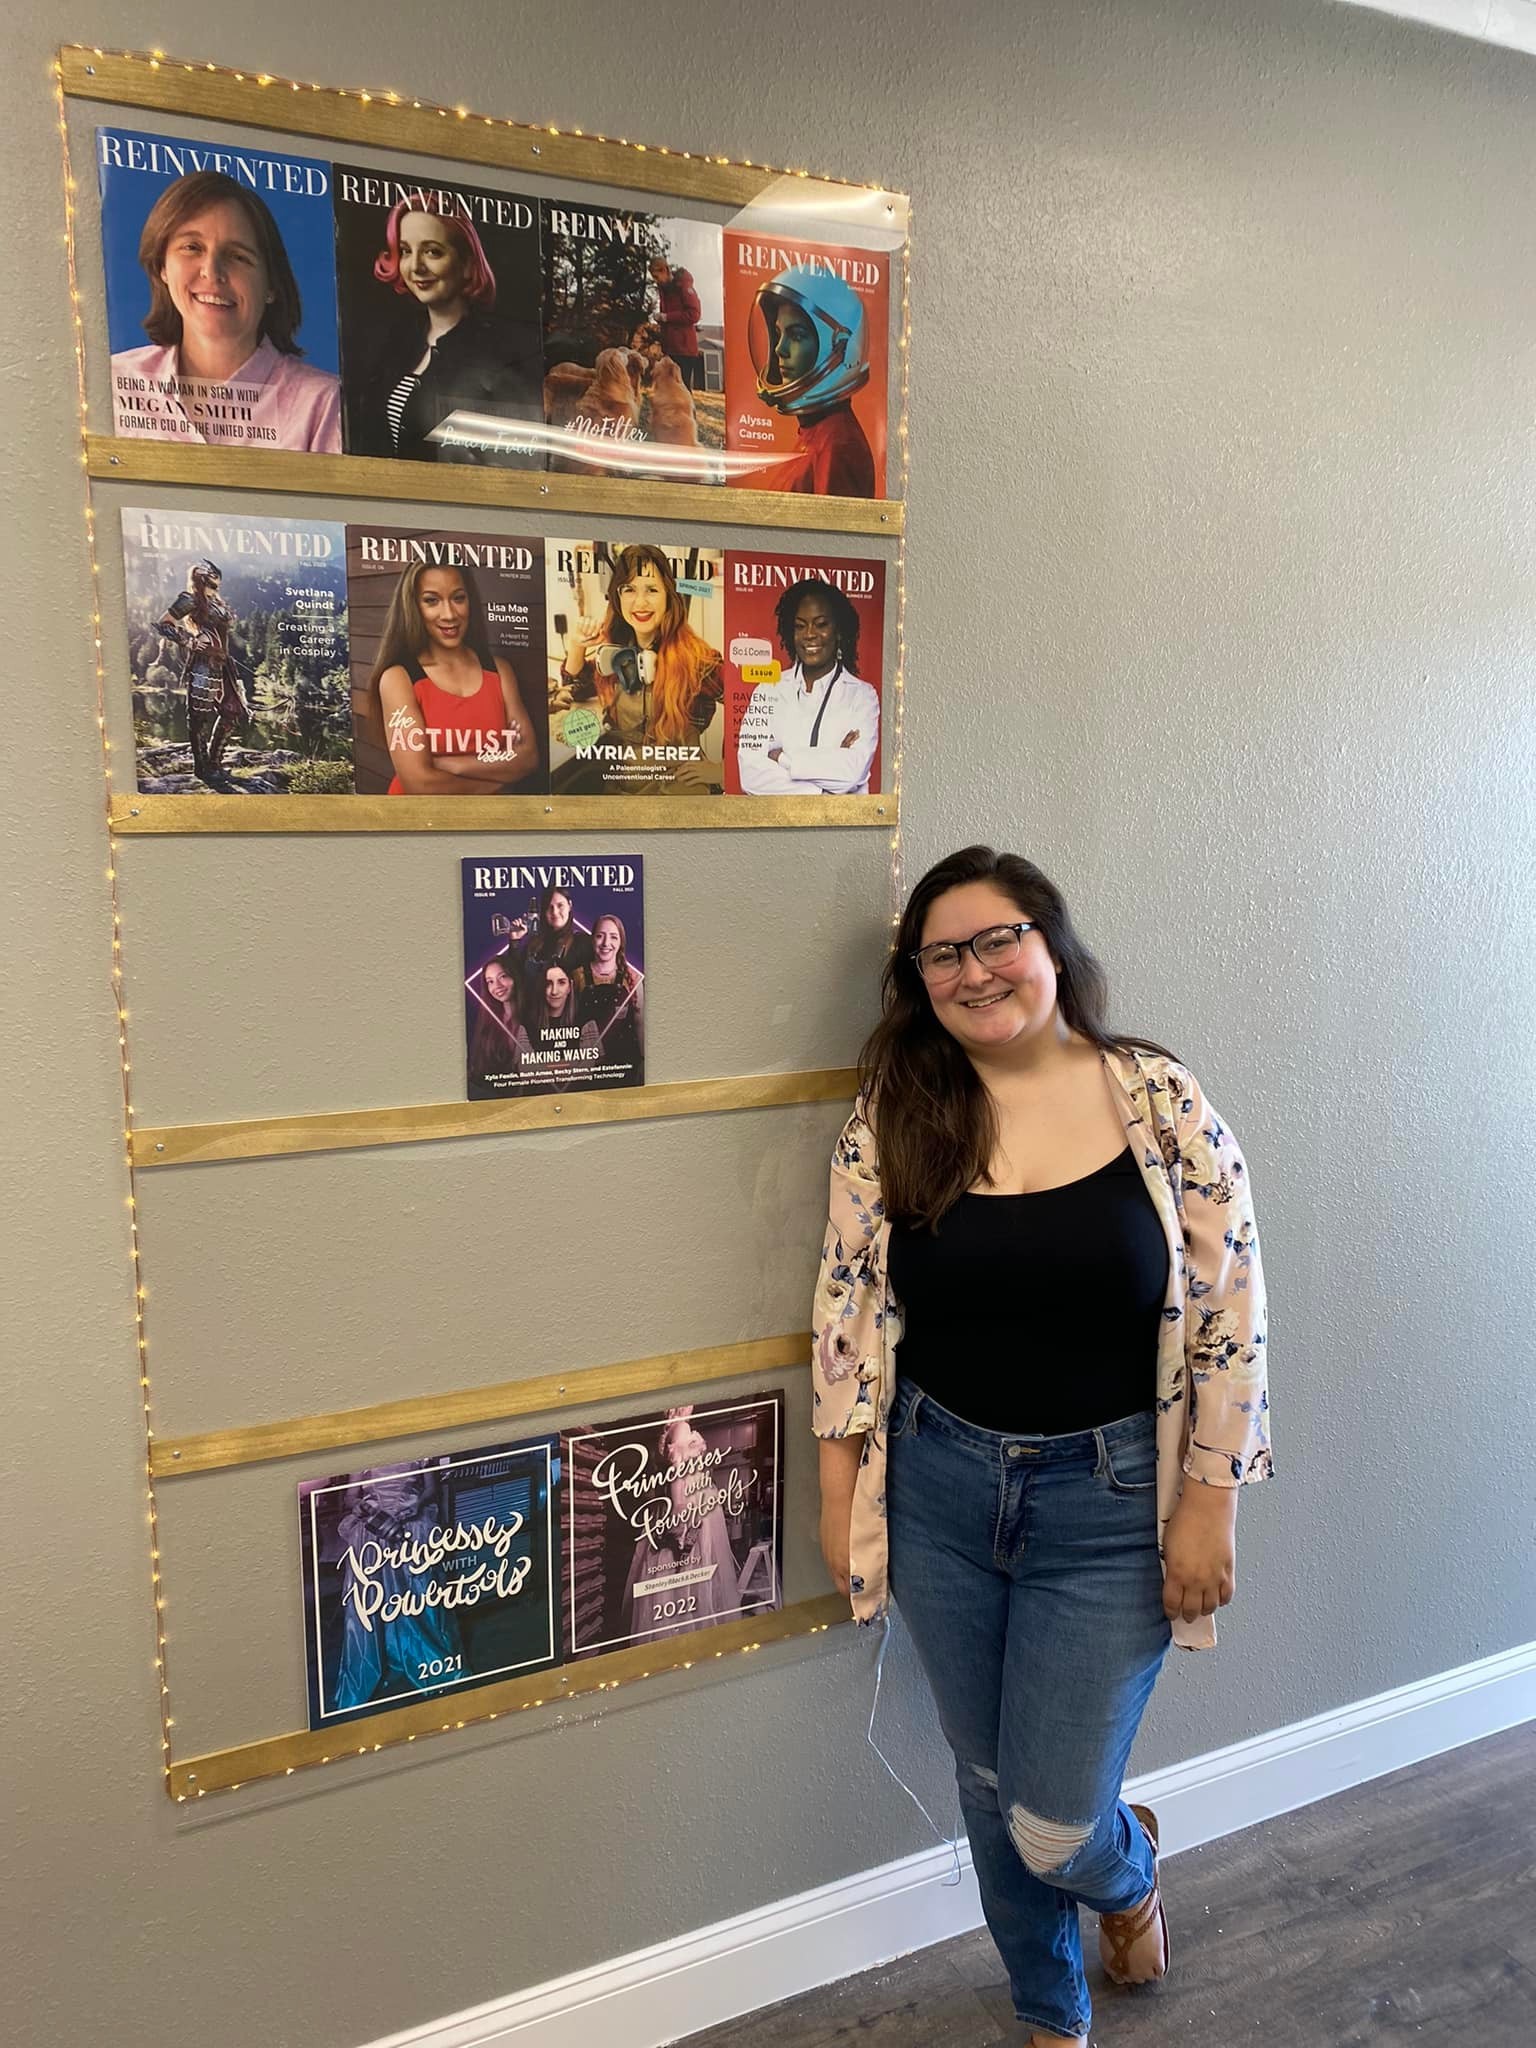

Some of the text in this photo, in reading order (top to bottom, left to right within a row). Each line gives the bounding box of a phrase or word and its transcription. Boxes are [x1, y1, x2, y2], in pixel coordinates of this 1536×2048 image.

[98, 135, 328, 197] REINVENTED
[340, 174, 533, 229] REINVENTED
[738, 243, 880, 286] REINVENTED
[118, 377, 259, 403] BEING A WOMAN IN STEM WITH
[119, 396, 252, 421] MEGAN SMITH
[120, 415, 277, 440] FORMER CTO OF THE UNITED STATES
[564, 415, 648, 442] #NoFilter
[739, 414, 772, 427] Alyssa
[739, 429, 775, 440] Carson
[140, 523, 332, 559] REINVENTED
[360, 536, 533, 571] REINVENTED
[678, 582, 698, 591] SPRING
[734, 563, 875, 592] REINVENTED
[285, 587, 334, 598] Svetlana
[296, 600, 334, 610] Quindt
[488, 602, 528, 613] Lisa Mae
[488, 612, 528, 623] Brunson
[278, 622, 325, 634] Creating
[299, 635, 335, 645] Career
[280, 646, 336, 658] in Cosplay
[733, 647, 770, 656] SciComm
[750, 668, 773, 676] issue
[733, 693, 766, 702] RAVEN
[389, 705, 416, 729] the
[733, 705, 774, 714] SCIENCE
[568, 726, 583, 735] next
[584, 722, 596, 731] gen
[733, 718, 768, 726] MAVEN
[390, 728, 517, 753] ACTIVIST
[477, 743, 517, 763] issue
[575, 745, 701, 760] MYRIA PEREZ
[474, 865, 634, 889] REINVENTED
[541, 1027, 580, 1040] MAKING
[554, 1040, 567, 1048] AND
[521, 1047, 599, 1065] MAKING WAVES
[591, 1443, 732, 1520] Princesses
[684, 1471, 713, 1496] with
[630, 1468, 758, 1550] Powertools
[442, 1555, 477, 1572] WITH
[647, 1555, 702, 1575] sponsored by
[342, 1557, 532, 1632] Powertools
[653, 1596, 697, 1621] 2022
[417, 1654, 463, 1680] 2021
